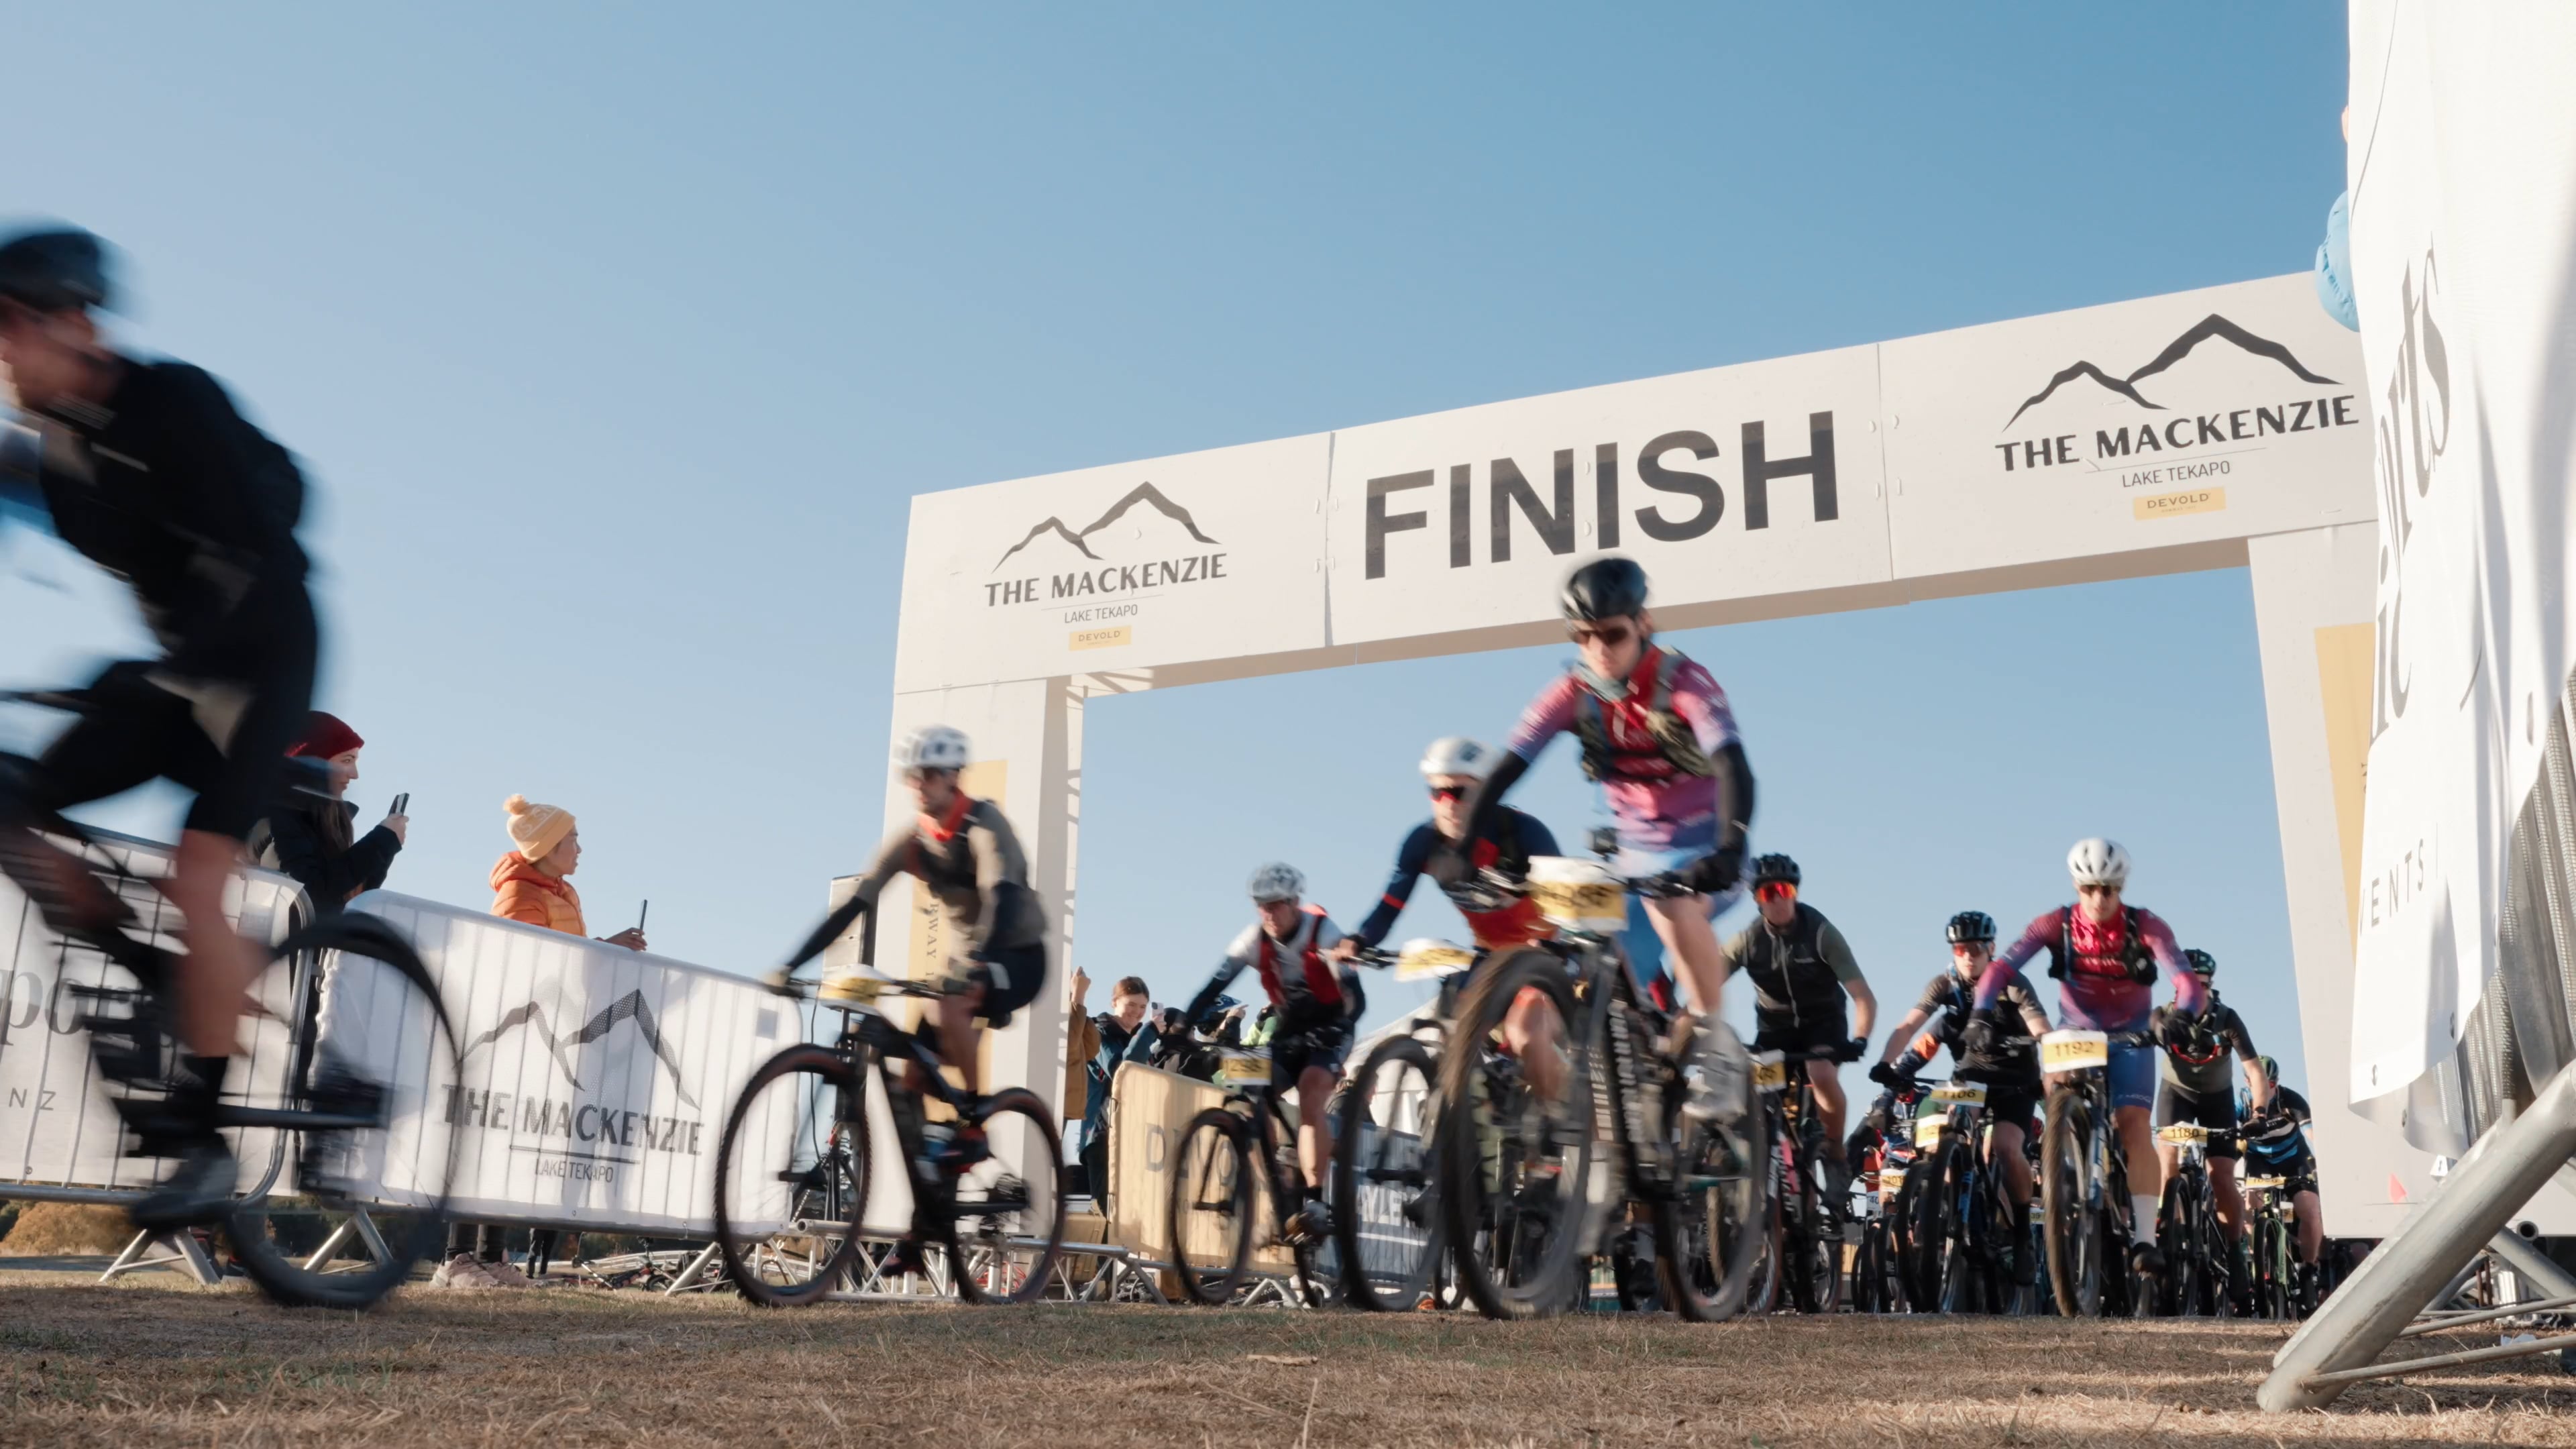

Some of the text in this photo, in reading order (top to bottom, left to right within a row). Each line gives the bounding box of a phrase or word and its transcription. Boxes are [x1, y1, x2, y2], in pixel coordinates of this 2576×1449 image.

[1995, 394, 2360, 472] THE MACKENZIE
[2122, 460, 2231, 488] LAKE TEKAPO
[1364, 411, 1839, 580] FINISH
[2147, 493, 2211, 509] DEVOLD
[984, 553, 1228, 606] THE MACKENZIE
[1064, 604, 1138, 623] LAKE TEKAPO
[1078, 631, 1120, 642] DEVOLD
[2055, 1041, 2095, 1057] 1192
[441, 1083, 705, 1157] THE MACKENZIE
[535, 1159, 614, 1183] LAKE TEKAPO
